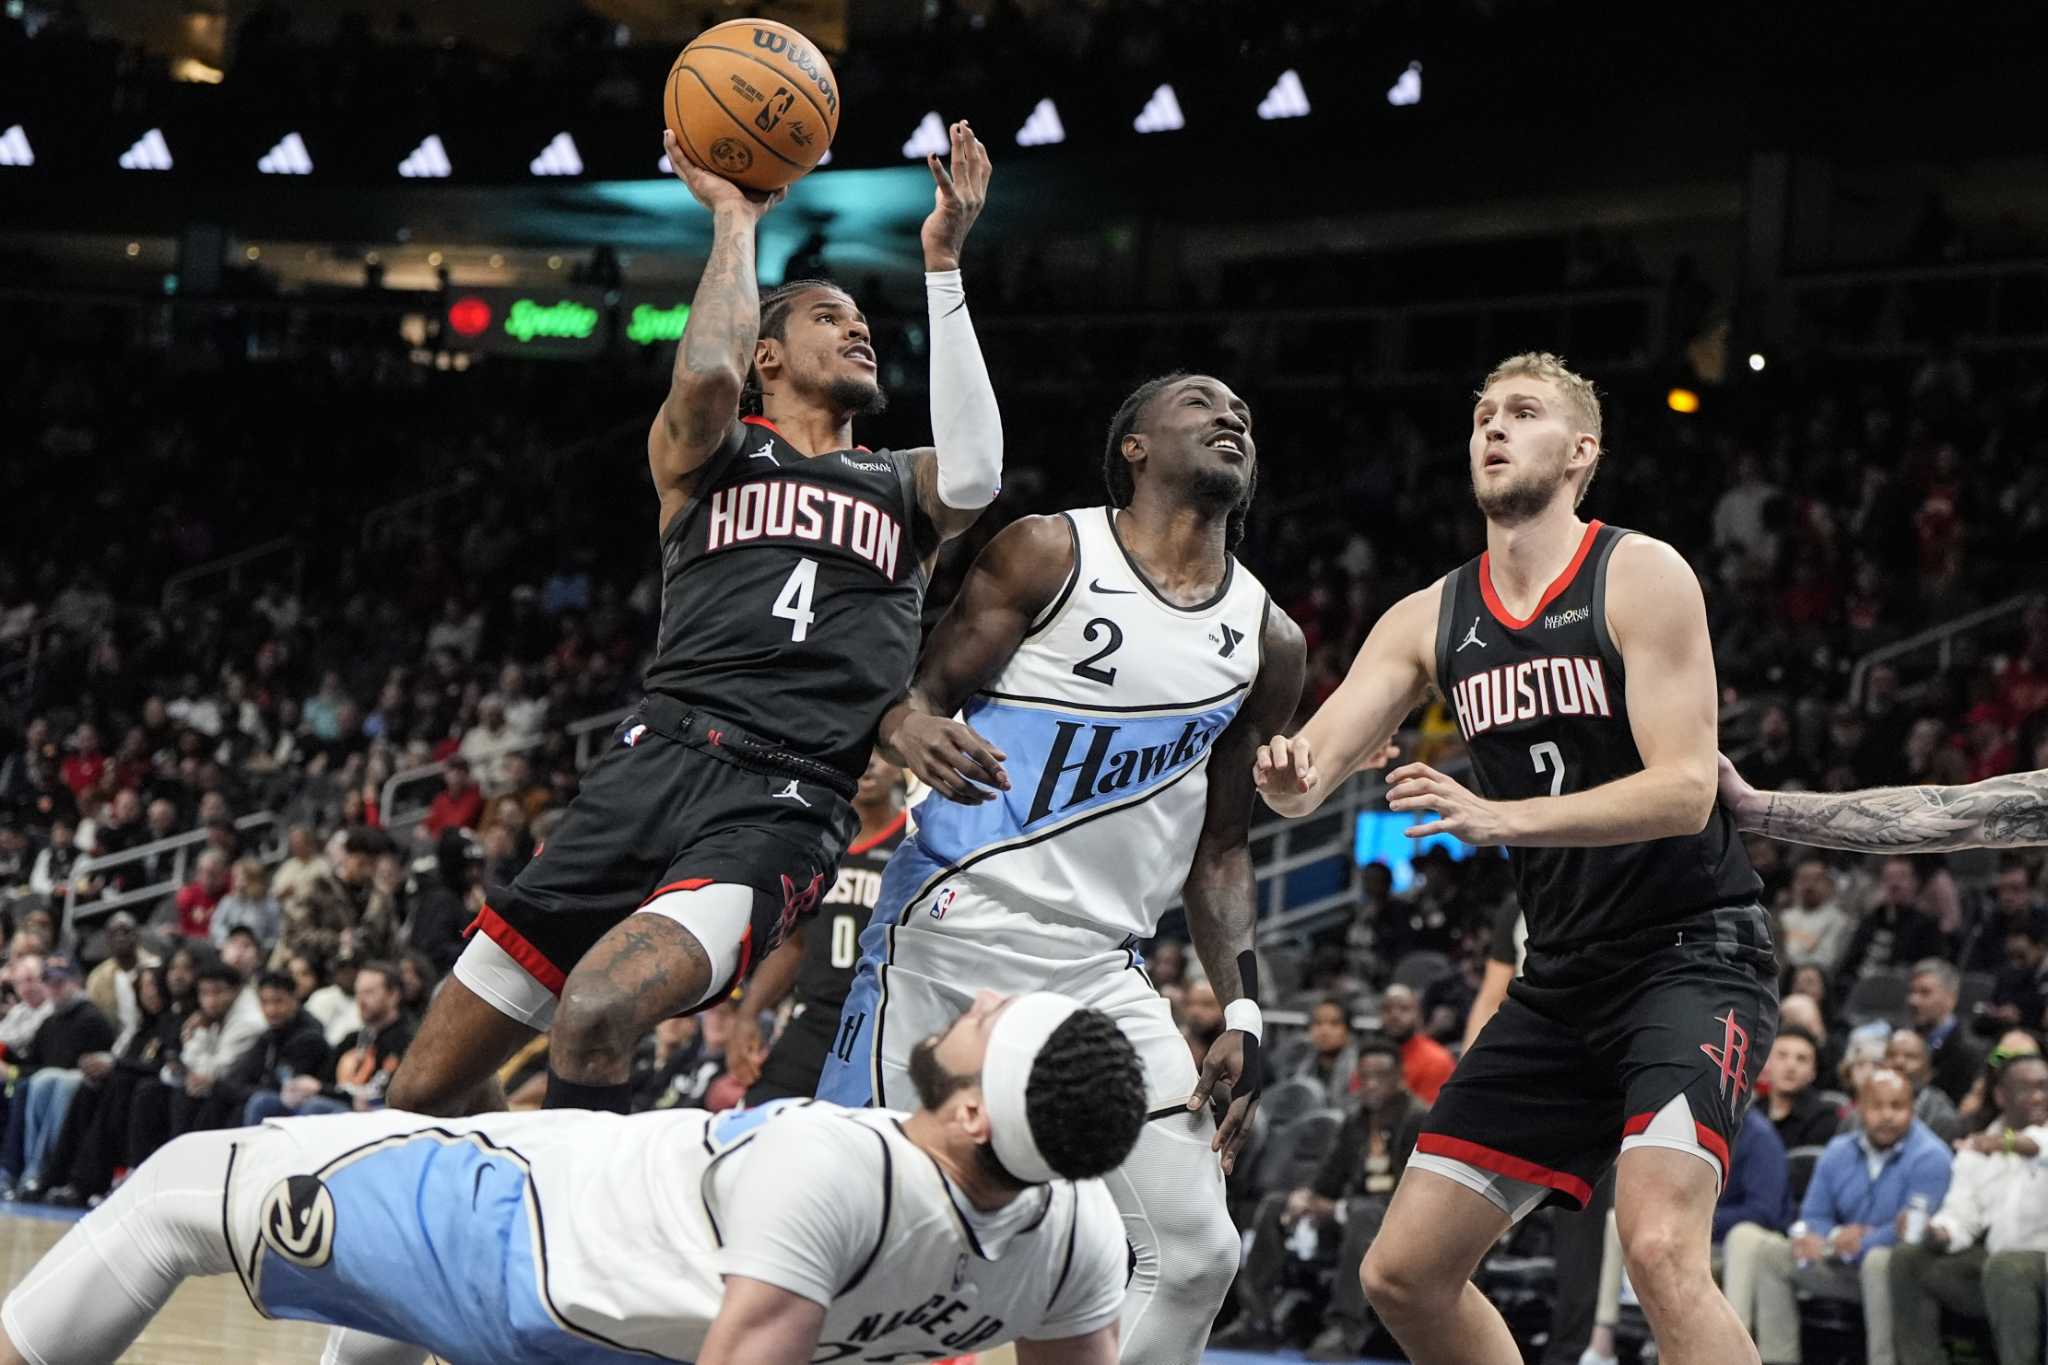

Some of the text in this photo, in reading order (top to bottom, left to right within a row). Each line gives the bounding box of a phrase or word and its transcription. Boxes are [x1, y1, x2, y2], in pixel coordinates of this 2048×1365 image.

[753, 28, 836, 115] Wilson
[707, 480, 901, 584] HOUSTON
[771, 557, 819, 642] 4
[1072, 617, 1124, 686] 2
[1452, 657, 1613, 742] HOUSTON
[1022, 720, 1220, 829] Hawks
[831, 915, 855, 969] 0
